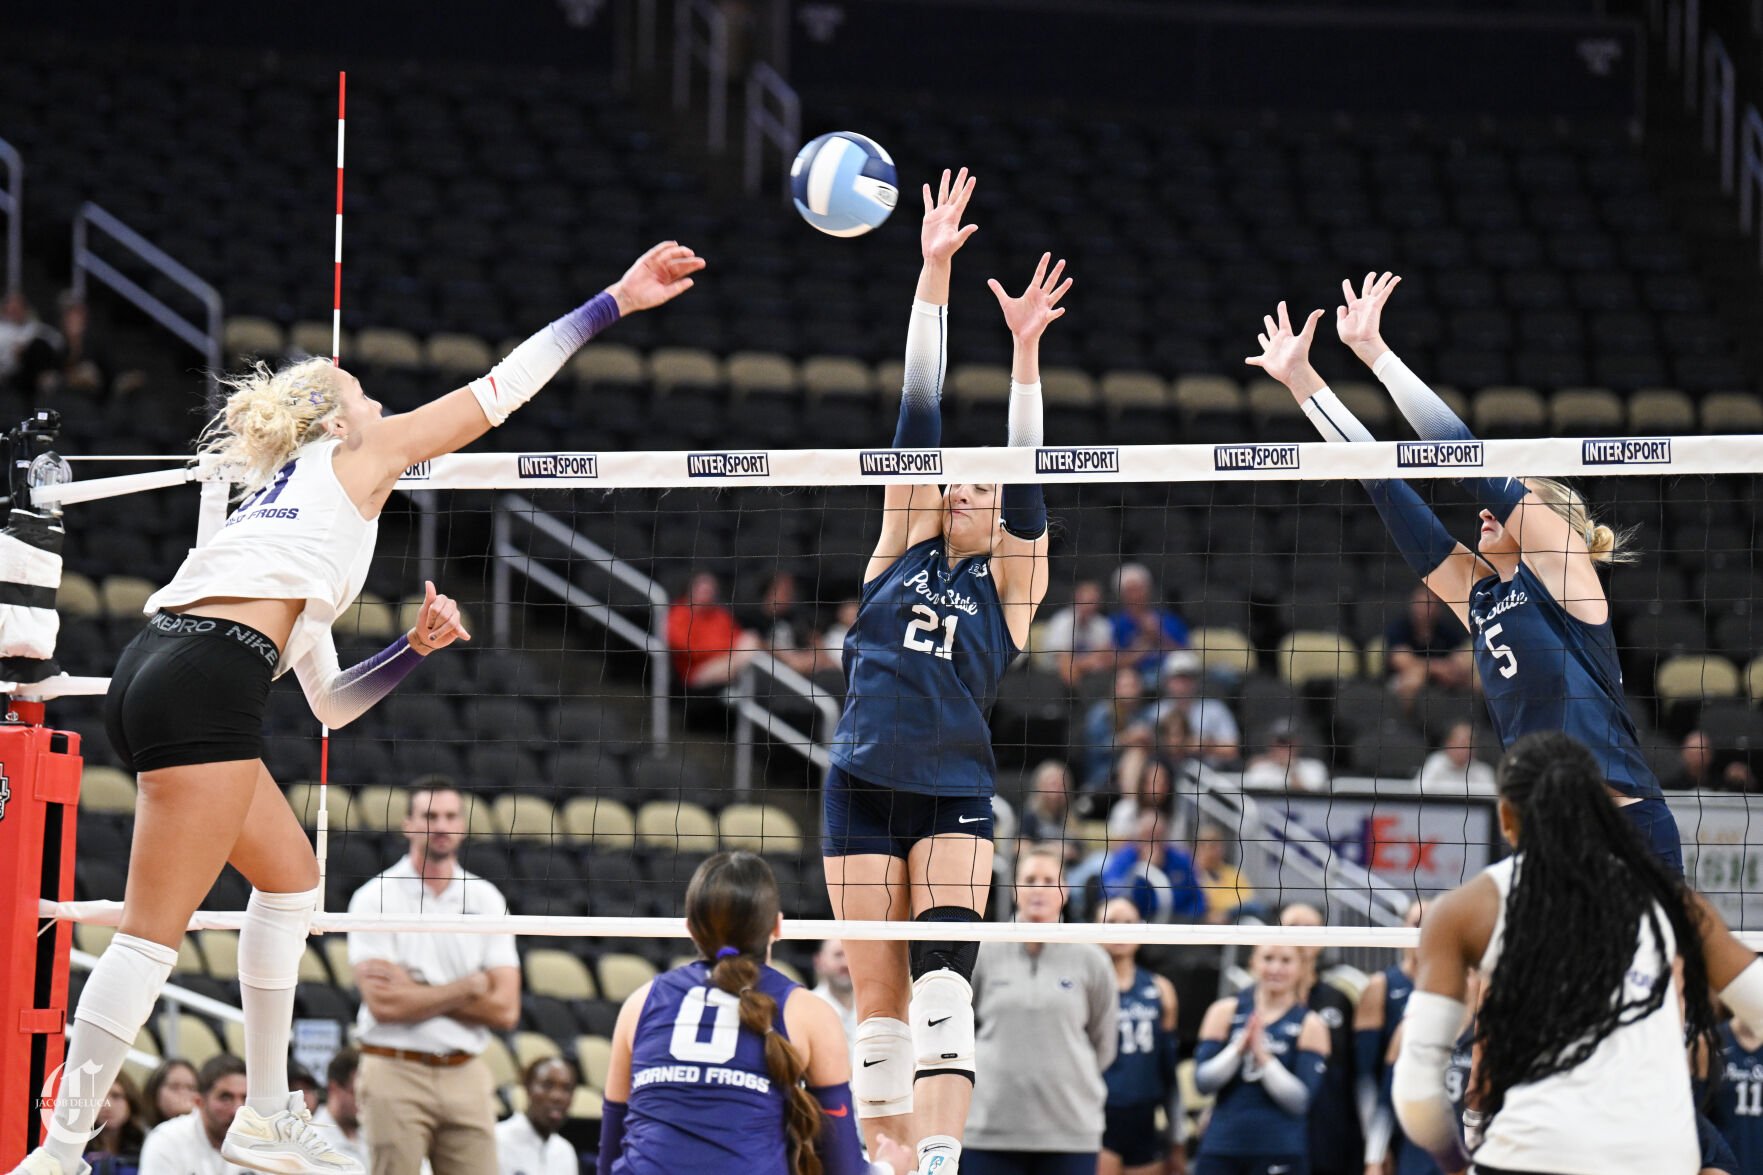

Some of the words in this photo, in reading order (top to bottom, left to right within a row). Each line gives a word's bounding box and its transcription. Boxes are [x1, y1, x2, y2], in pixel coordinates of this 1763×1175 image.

[247, 508, 299, 520] FROGS
[940, 589, 978, 616] State
[225, 625, 279, 667] NIKE
[903, 604, 958, 660] 21
[1484, 622, 1518, 679] 5
[669, 985, 741, 1064] 0
[1119, 1020, 1154, 1054] 14
[704, 1067, 771, 1094] FROGS
